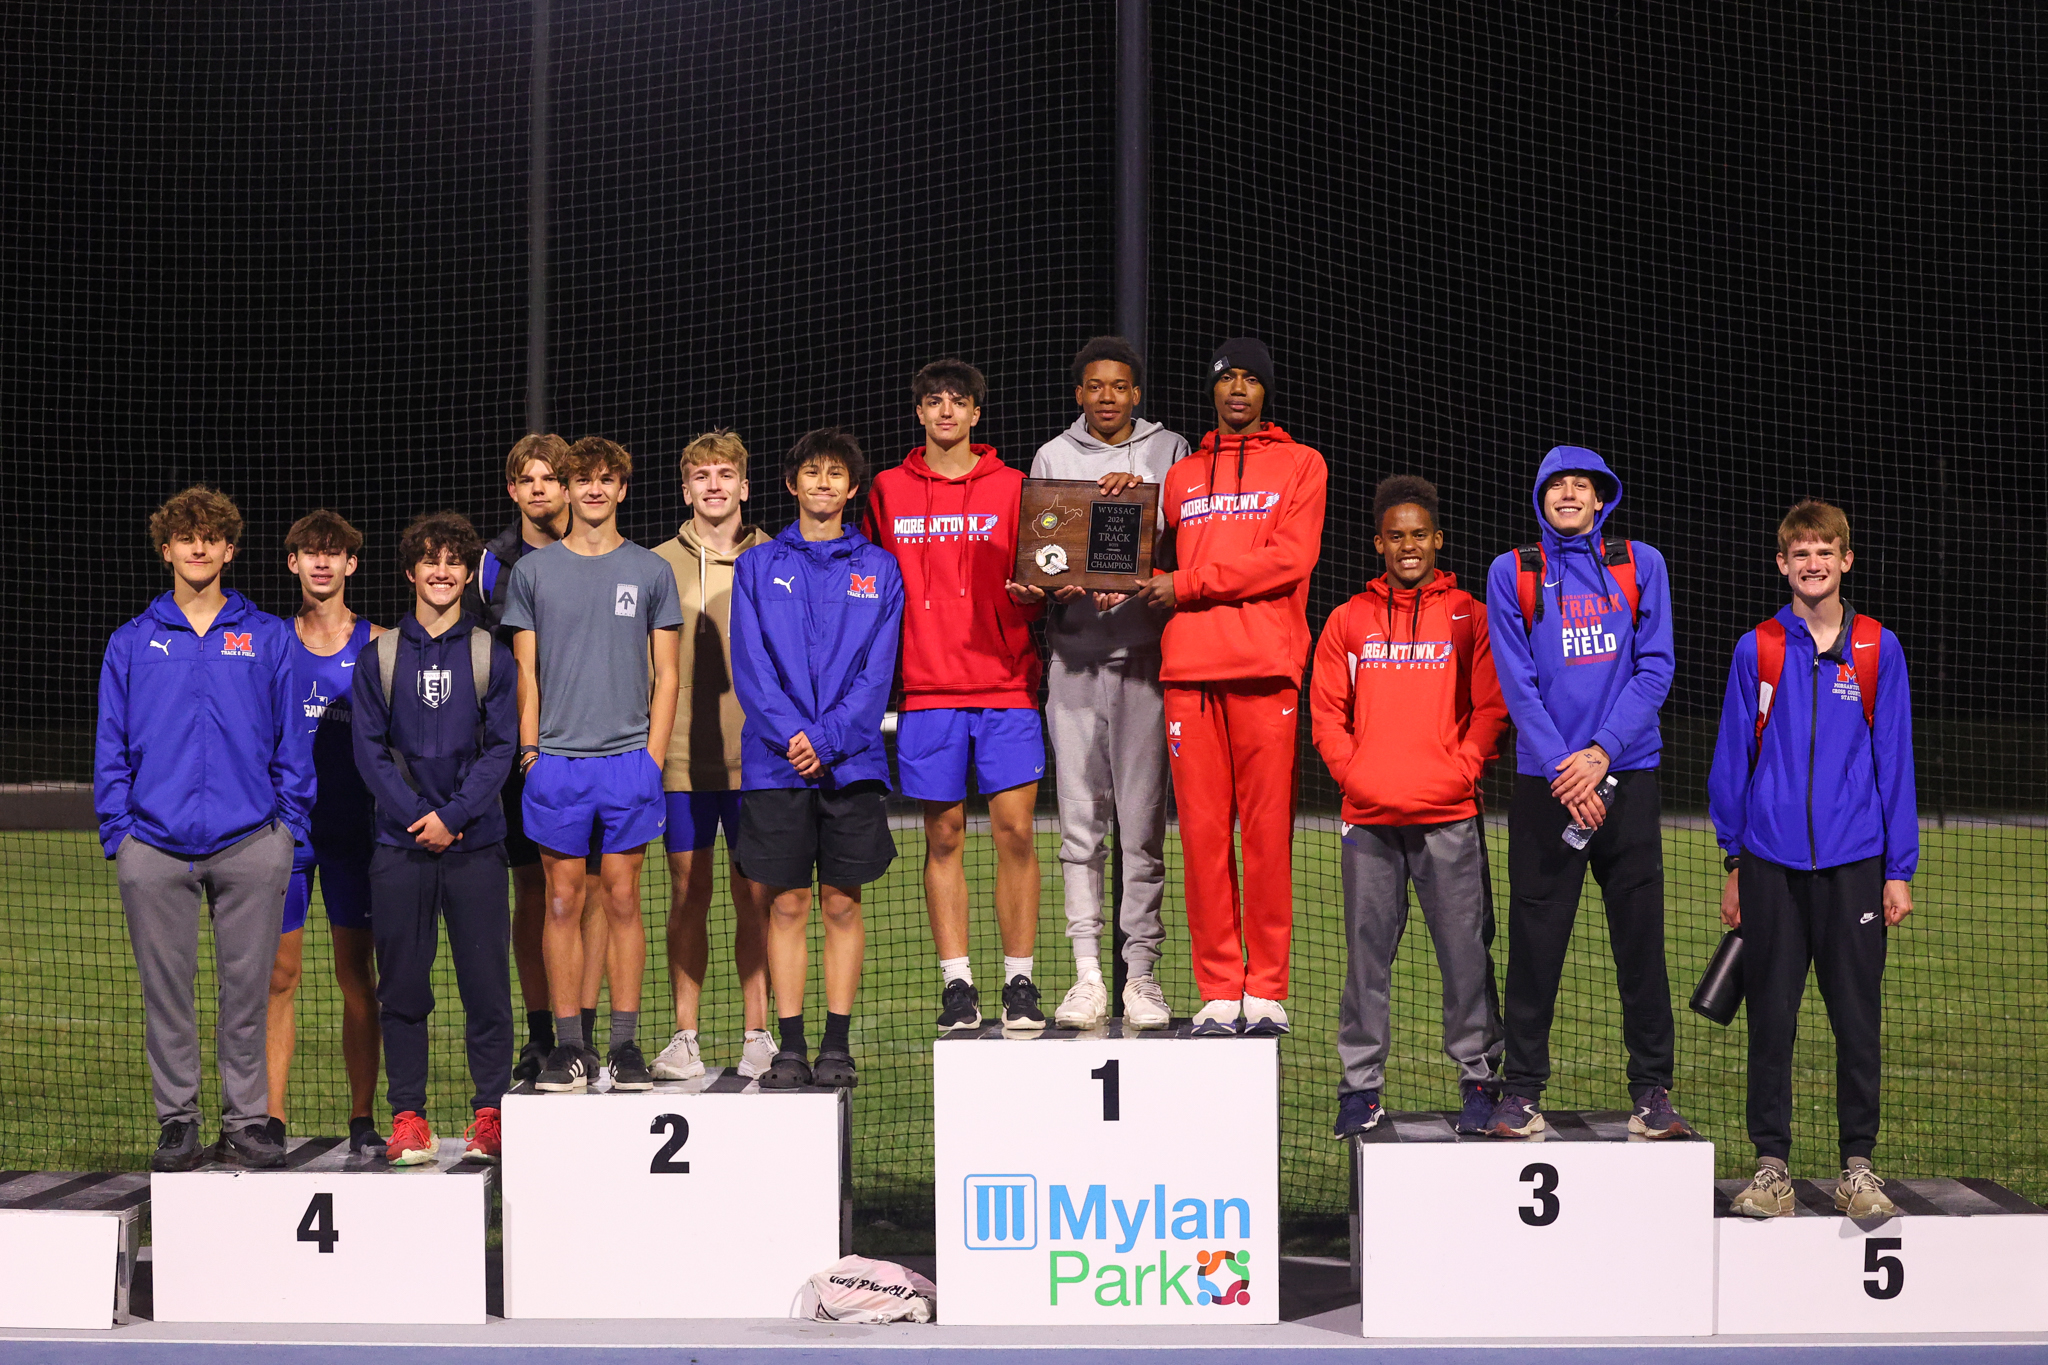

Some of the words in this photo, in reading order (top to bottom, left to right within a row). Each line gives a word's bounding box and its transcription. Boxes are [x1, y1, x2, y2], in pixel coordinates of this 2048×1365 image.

[1099, 506, 1135, 515] WVSSAC
[1180, 494, 1259, 520] MORGANTOWN
[1183, 513, 1213, 527] TRACK
[896, 536, 932, 544] TRACK
[1099, 533, 1130, 542] TRACK
[1090, 561, 1133, 570] CHAMPION
[1093, 553, 1132, 561] REGIONAL
[847, 590, 861, 598] TRACK
[850, 573, 876, 594] M
[1558, 593, 1623, 619] TRACK
[1562, 616, 1603, 639] AND
[224, 632, 252, 652] M
[1562, 633, 1617, 657] FIELD
[1169, 721, 1182, 736] M
[1091, 1059, 1120, 1121] 1
[650, 1114, 689, 1173] 2
[1518, 1163, 1560, 1226] 3
[296, 1193, 339, 1254] 4
[1049, 1184, 1250, 1253] Mylan
[1050, 1250, 1193, 1307] Park
[1863, 1237, 1905, 1300] 5
